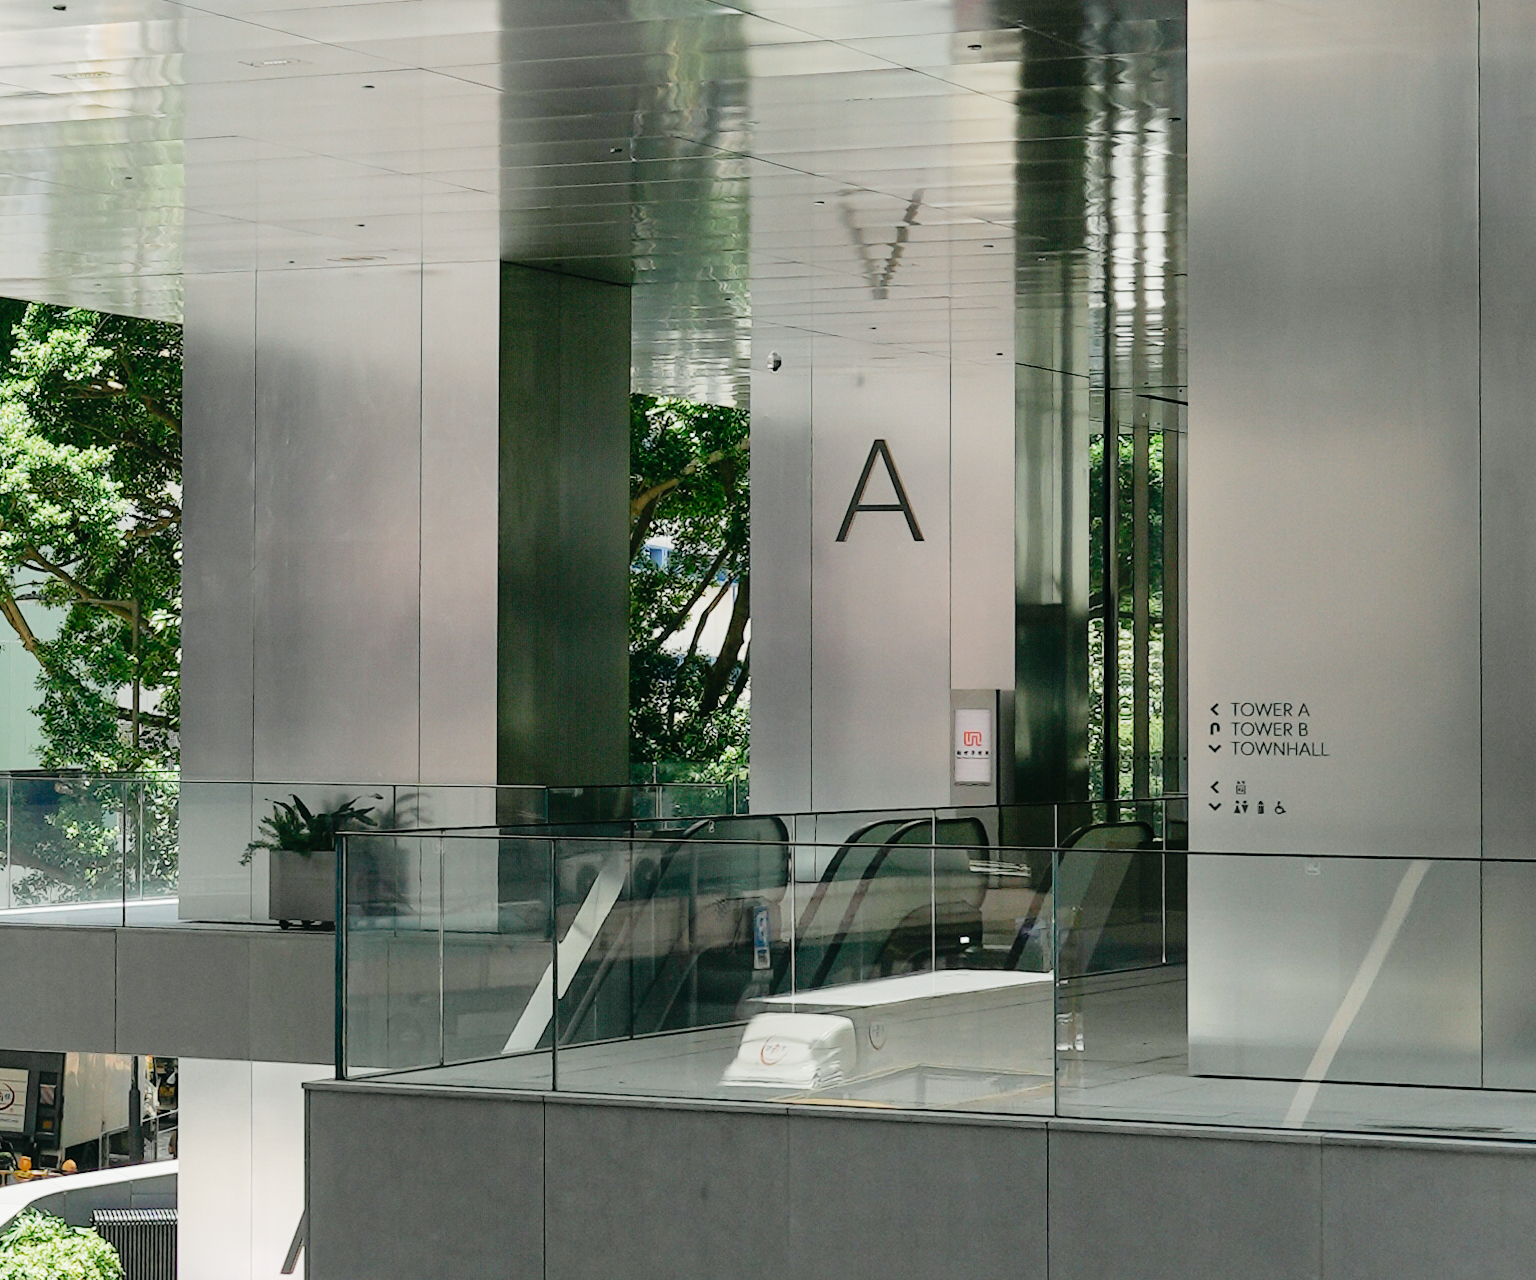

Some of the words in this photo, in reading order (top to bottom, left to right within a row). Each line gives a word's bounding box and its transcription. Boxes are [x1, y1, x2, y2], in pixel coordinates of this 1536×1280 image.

[835, 439, 924, 542] A
[1230, 702, 1293, 717] TOWER
[1298, 703, 1310, 717] A
[1230, 722, 1293, 737] TOWER
[1299, 723, 1309, 737] B
[1230, 741, 1330, 757] TOWNHALL
